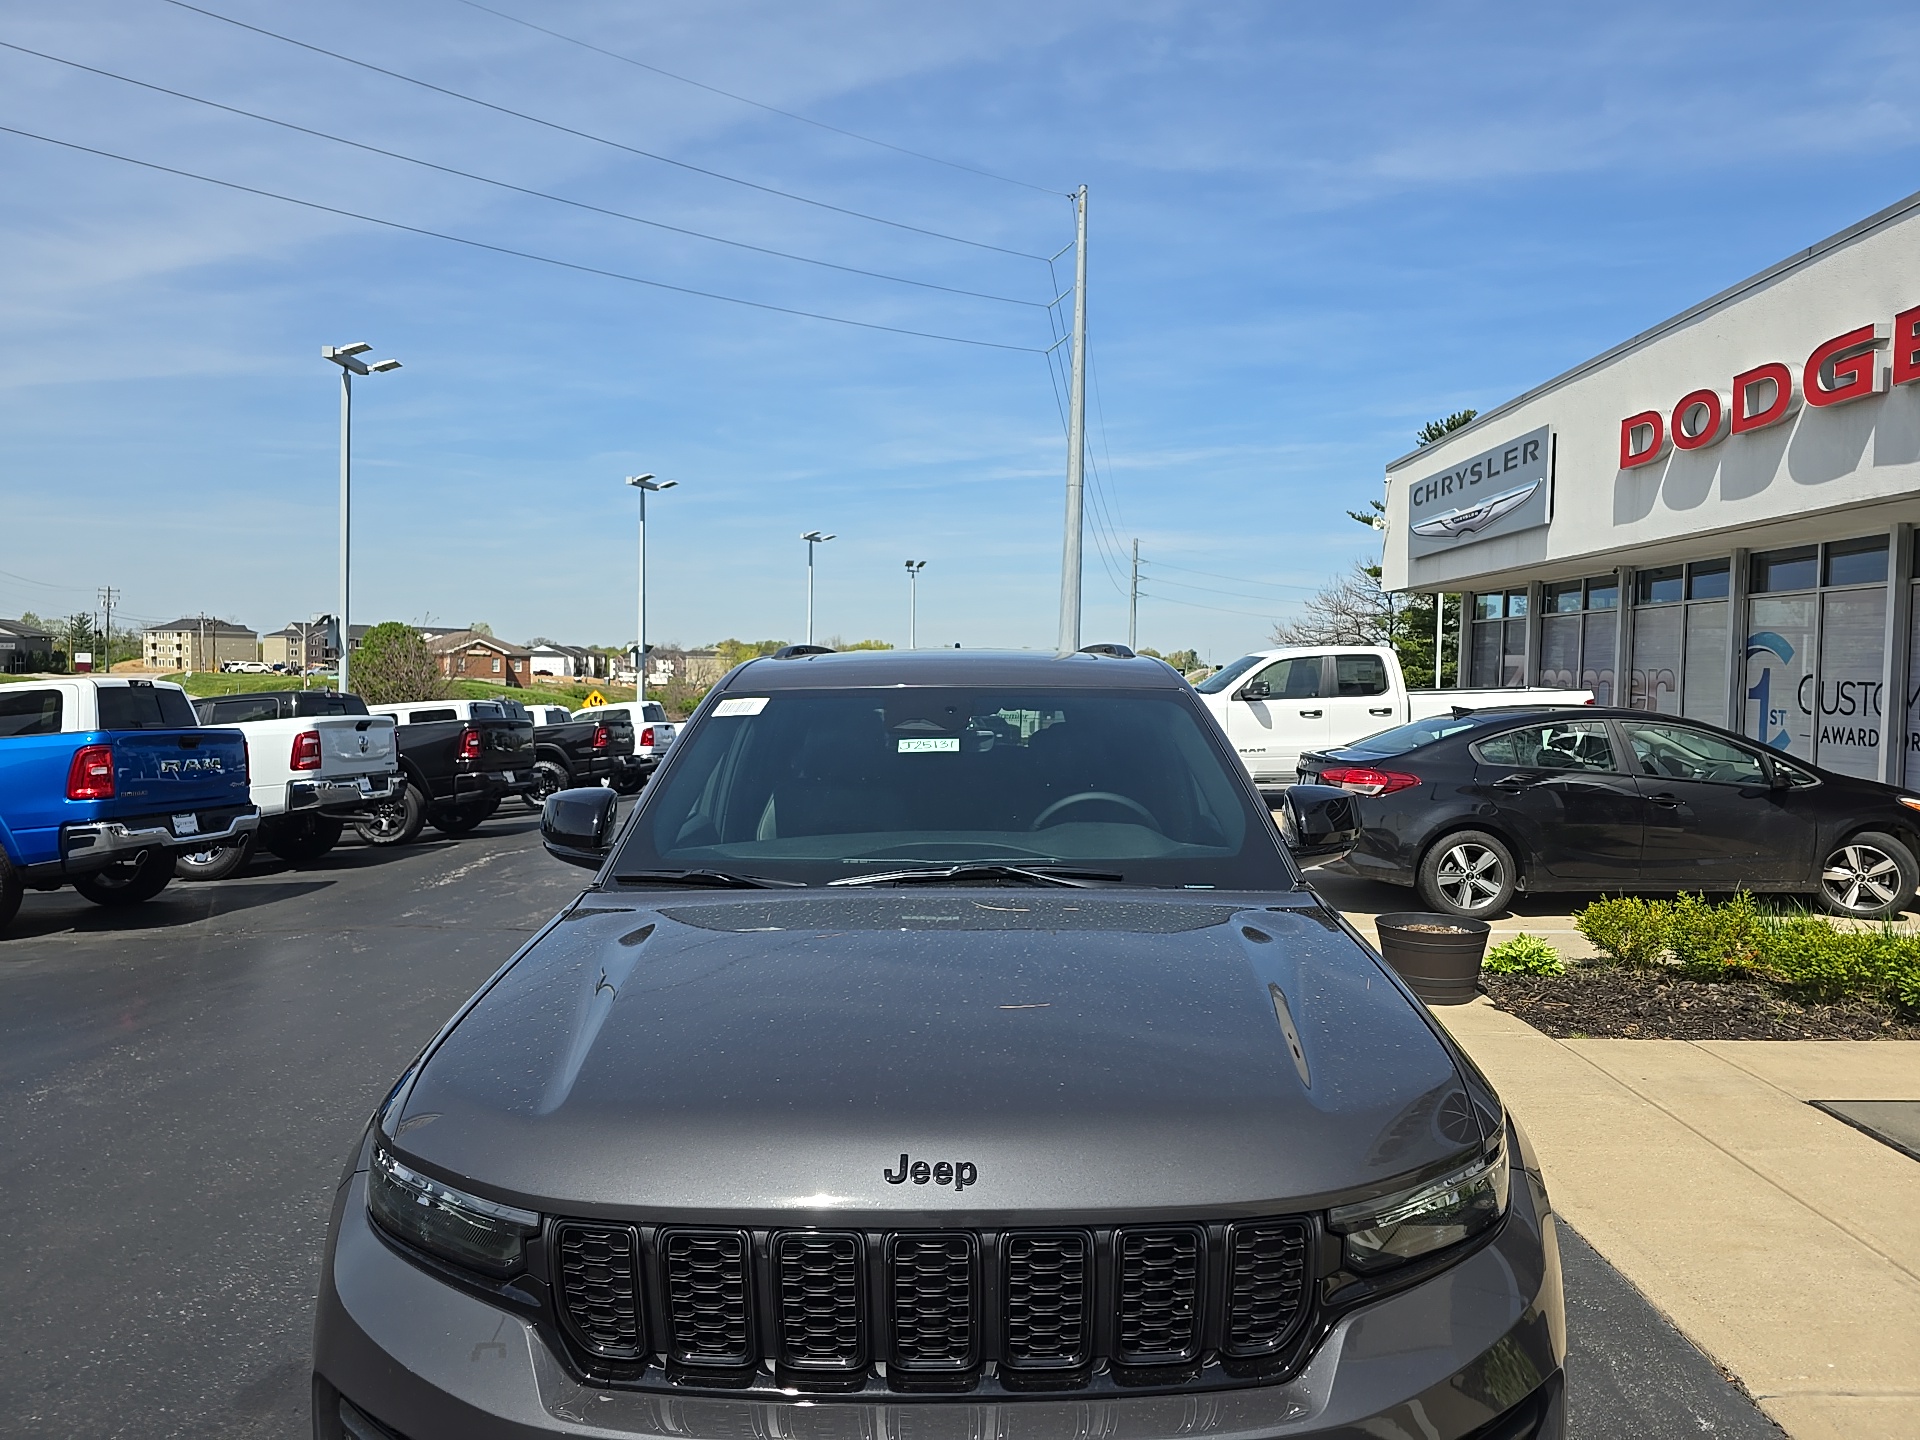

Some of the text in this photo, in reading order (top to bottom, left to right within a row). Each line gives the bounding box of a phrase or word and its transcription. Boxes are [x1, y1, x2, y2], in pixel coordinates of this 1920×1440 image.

[1413, 439, 1540, 507] CHRYSLER
[1497, 654, 1675, 711] Zmmer
[1820, 726, 1879, 747] AWARD
[161, 758, 221, 773] RAM
[884, 1153, 978, 1192] Jeep
